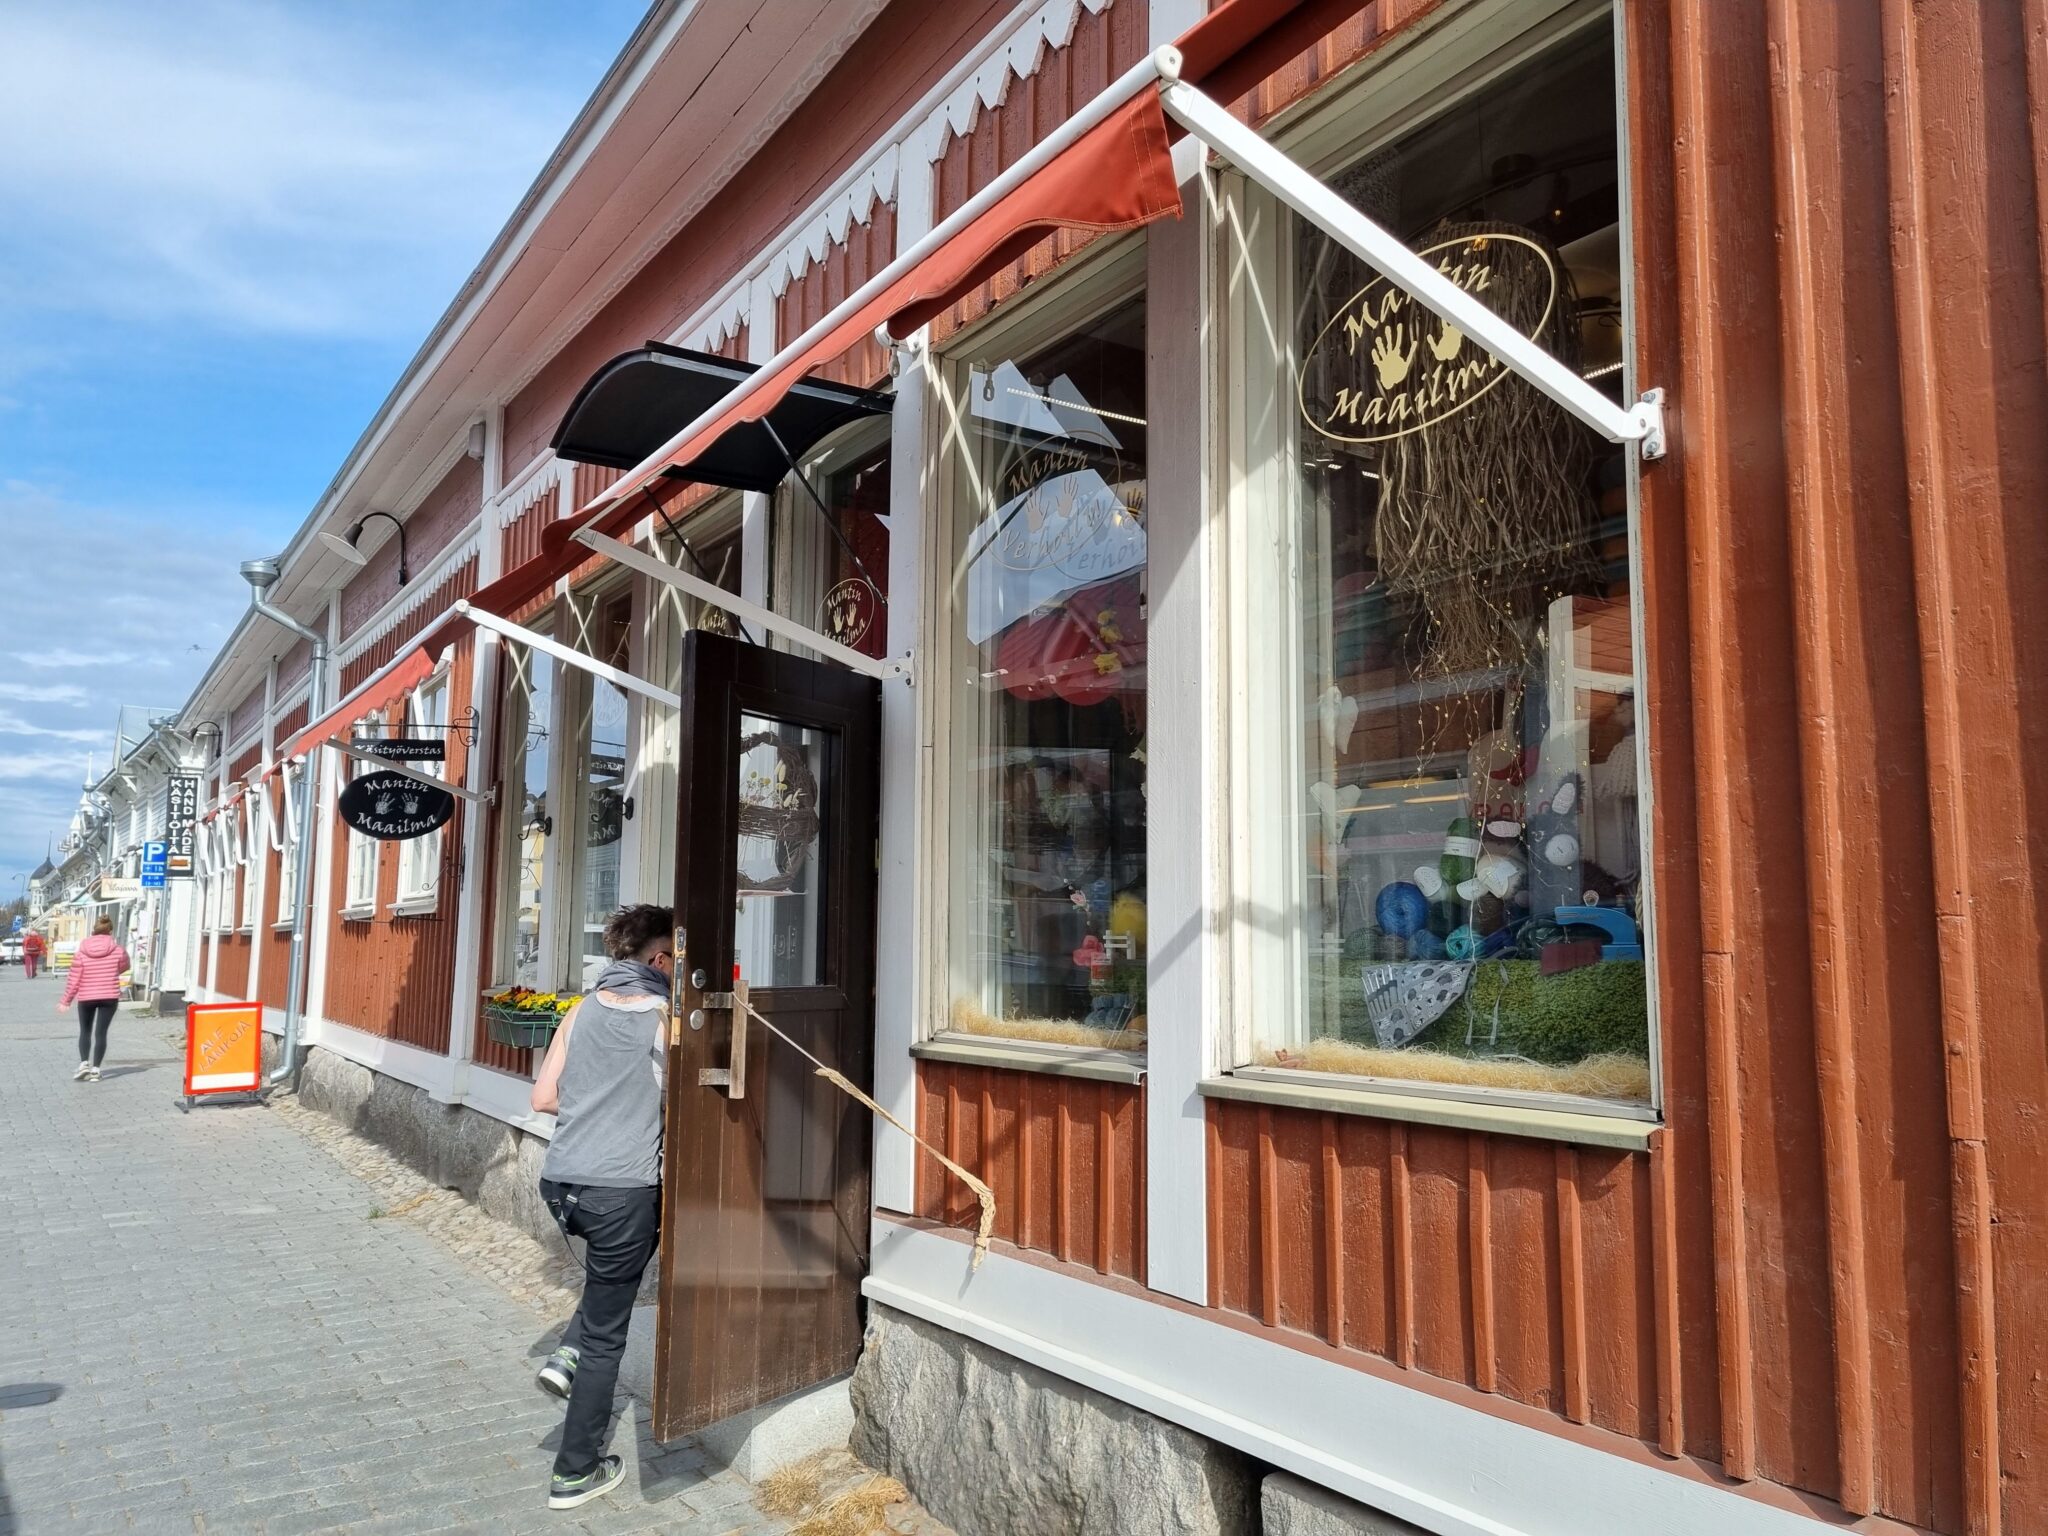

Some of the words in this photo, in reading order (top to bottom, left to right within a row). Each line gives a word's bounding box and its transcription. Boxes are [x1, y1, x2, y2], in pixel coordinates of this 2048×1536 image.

[1342, 247, 1492, 356] Matin
[1326, 352, 1499, 426] Maailm
[1009, 437, 1089, 505] Mantin
[827, 582, 862, 616] Mantin
[183, 779, 195, 815] HAND
[364, 777, 430, 796] Mantin
[168, 779, 182, 855] KÄSITÖITÄ
[355, 811, 437, 835] Maailma
[147, 843, 164, 862] P
[181, 818, 195, 855] MADE
